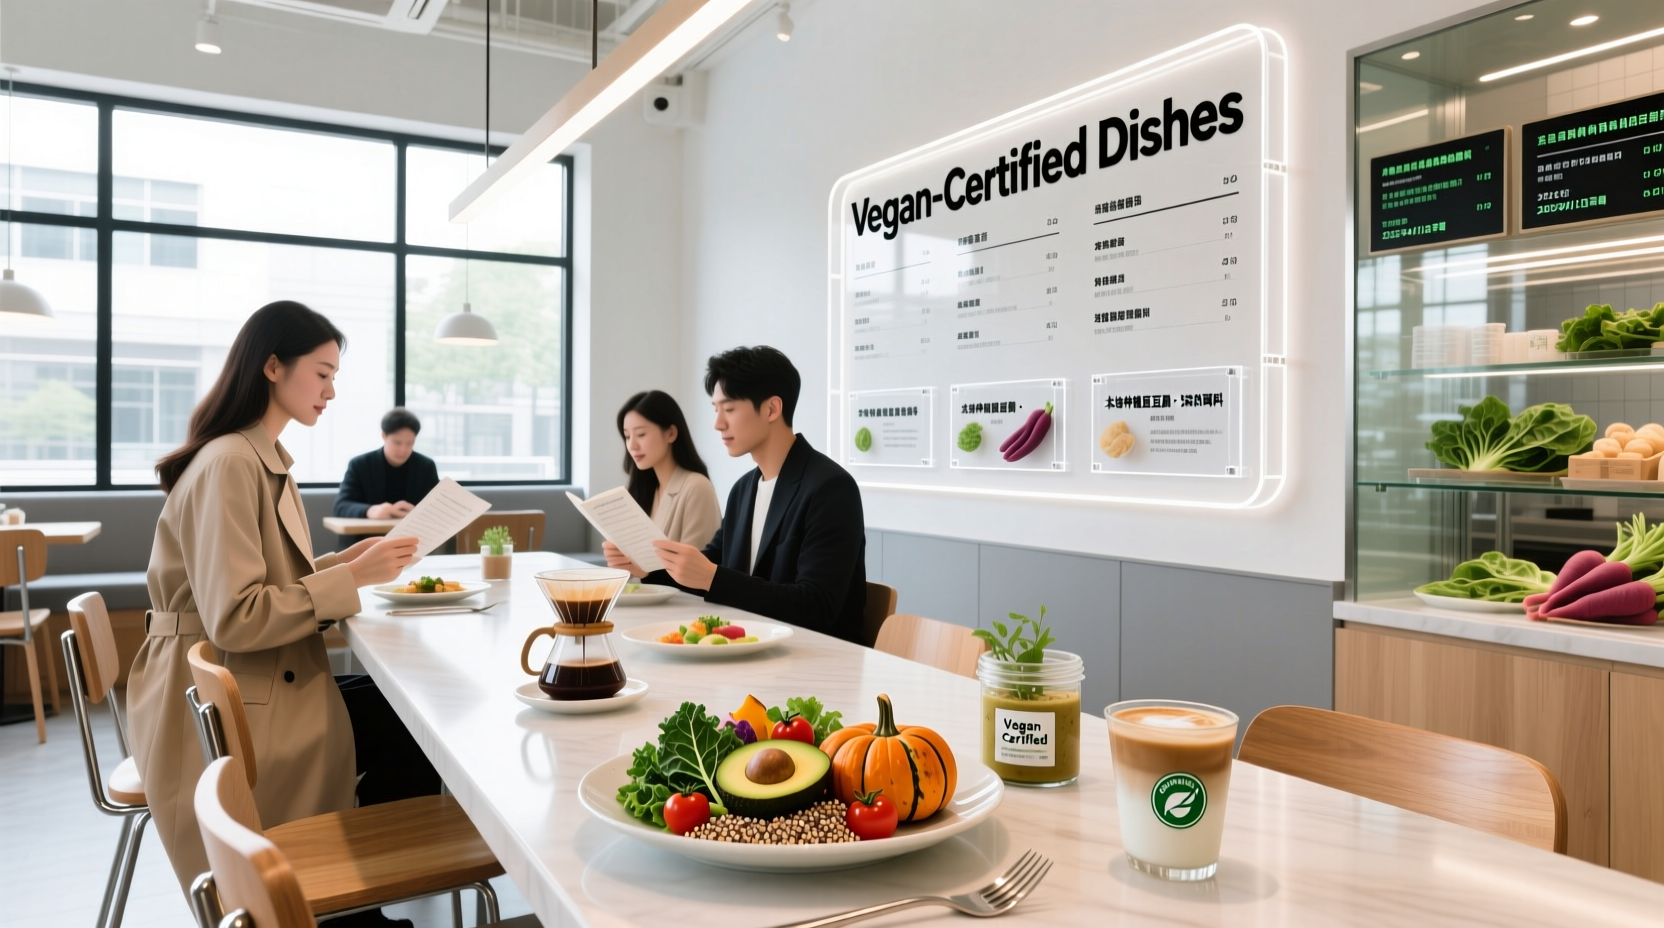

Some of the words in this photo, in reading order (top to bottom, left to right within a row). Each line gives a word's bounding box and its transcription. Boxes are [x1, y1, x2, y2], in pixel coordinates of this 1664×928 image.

[852, 124, 1087, 240] Vegan-Certified
[1098, 91, 1244, 170] Dishes
[1004, 718, 1041, 735] Vegan
